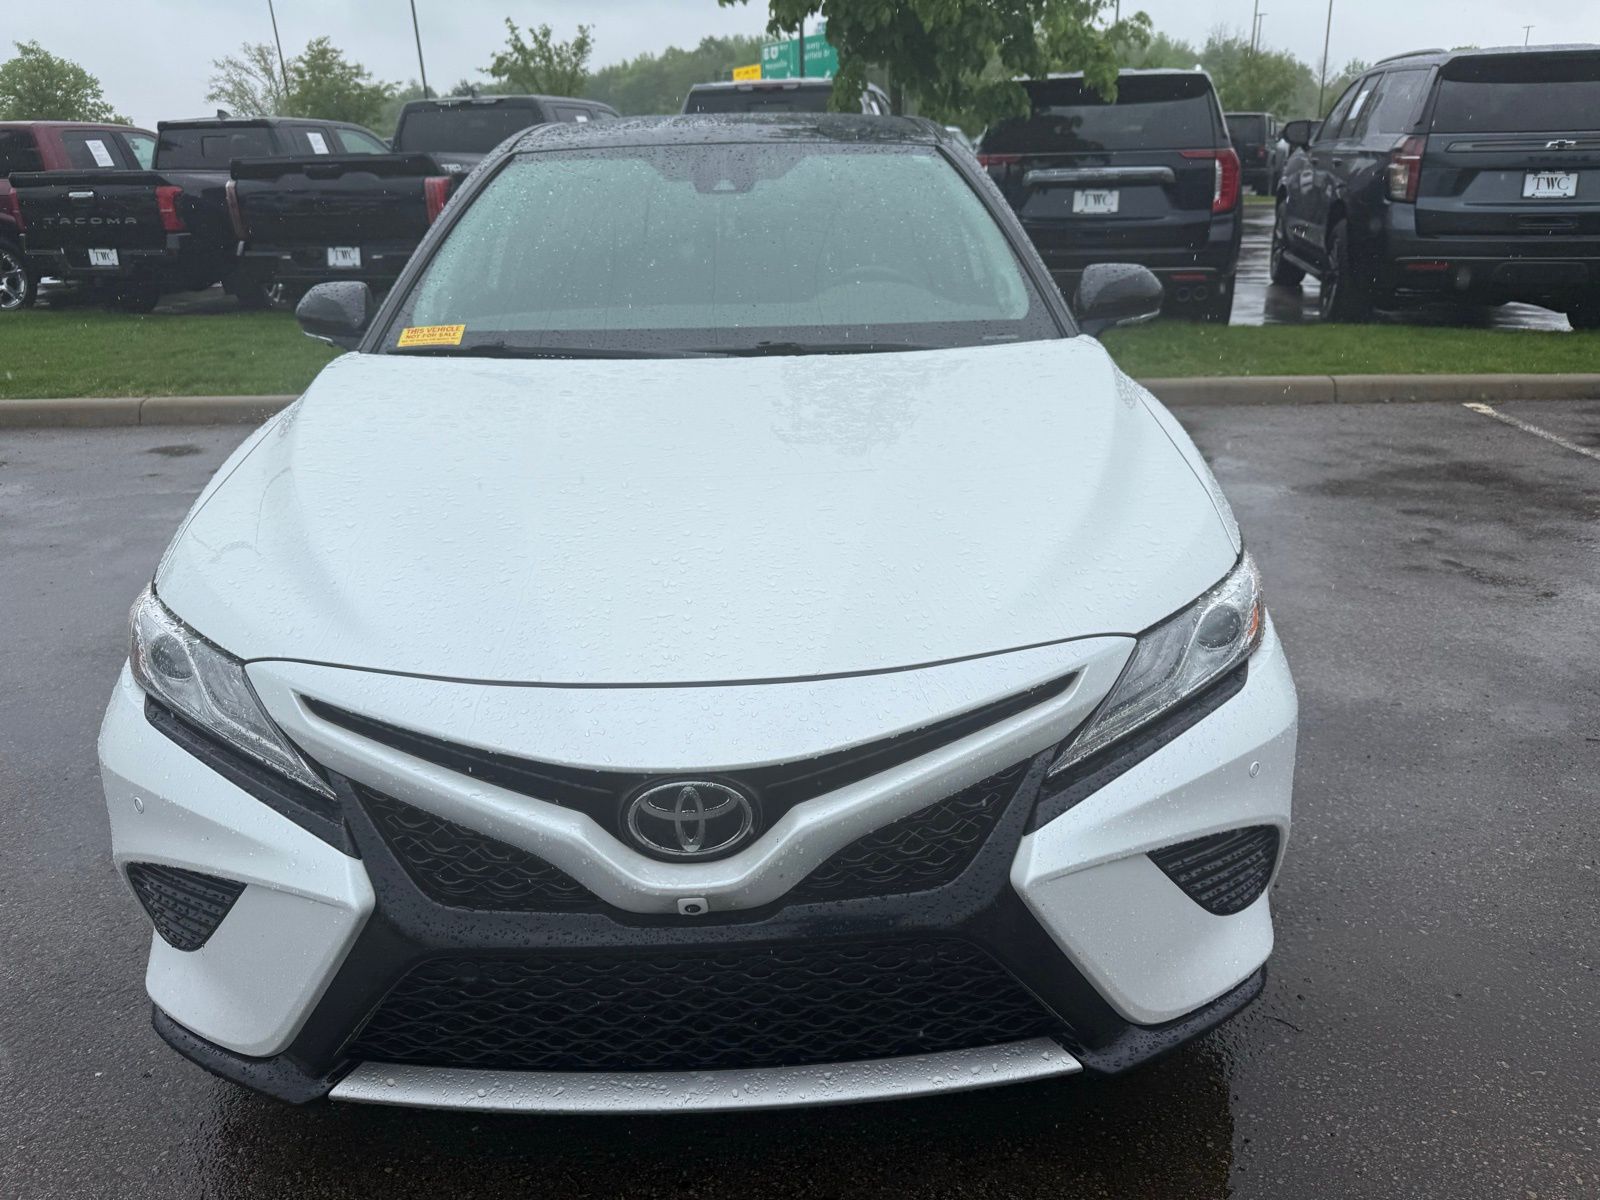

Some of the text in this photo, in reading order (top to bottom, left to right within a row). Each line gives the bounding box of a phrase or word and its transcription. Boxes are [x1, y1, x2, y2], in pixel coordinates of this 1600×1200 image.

[1532, 176, 1570, 191] TWC
[1082, 193, 1113, 207] TWC
[43, 217, 137, 225] TACOMA
[94, 251, 114, 261] TWC
[427, 325, 460, 333] VEHICLE
